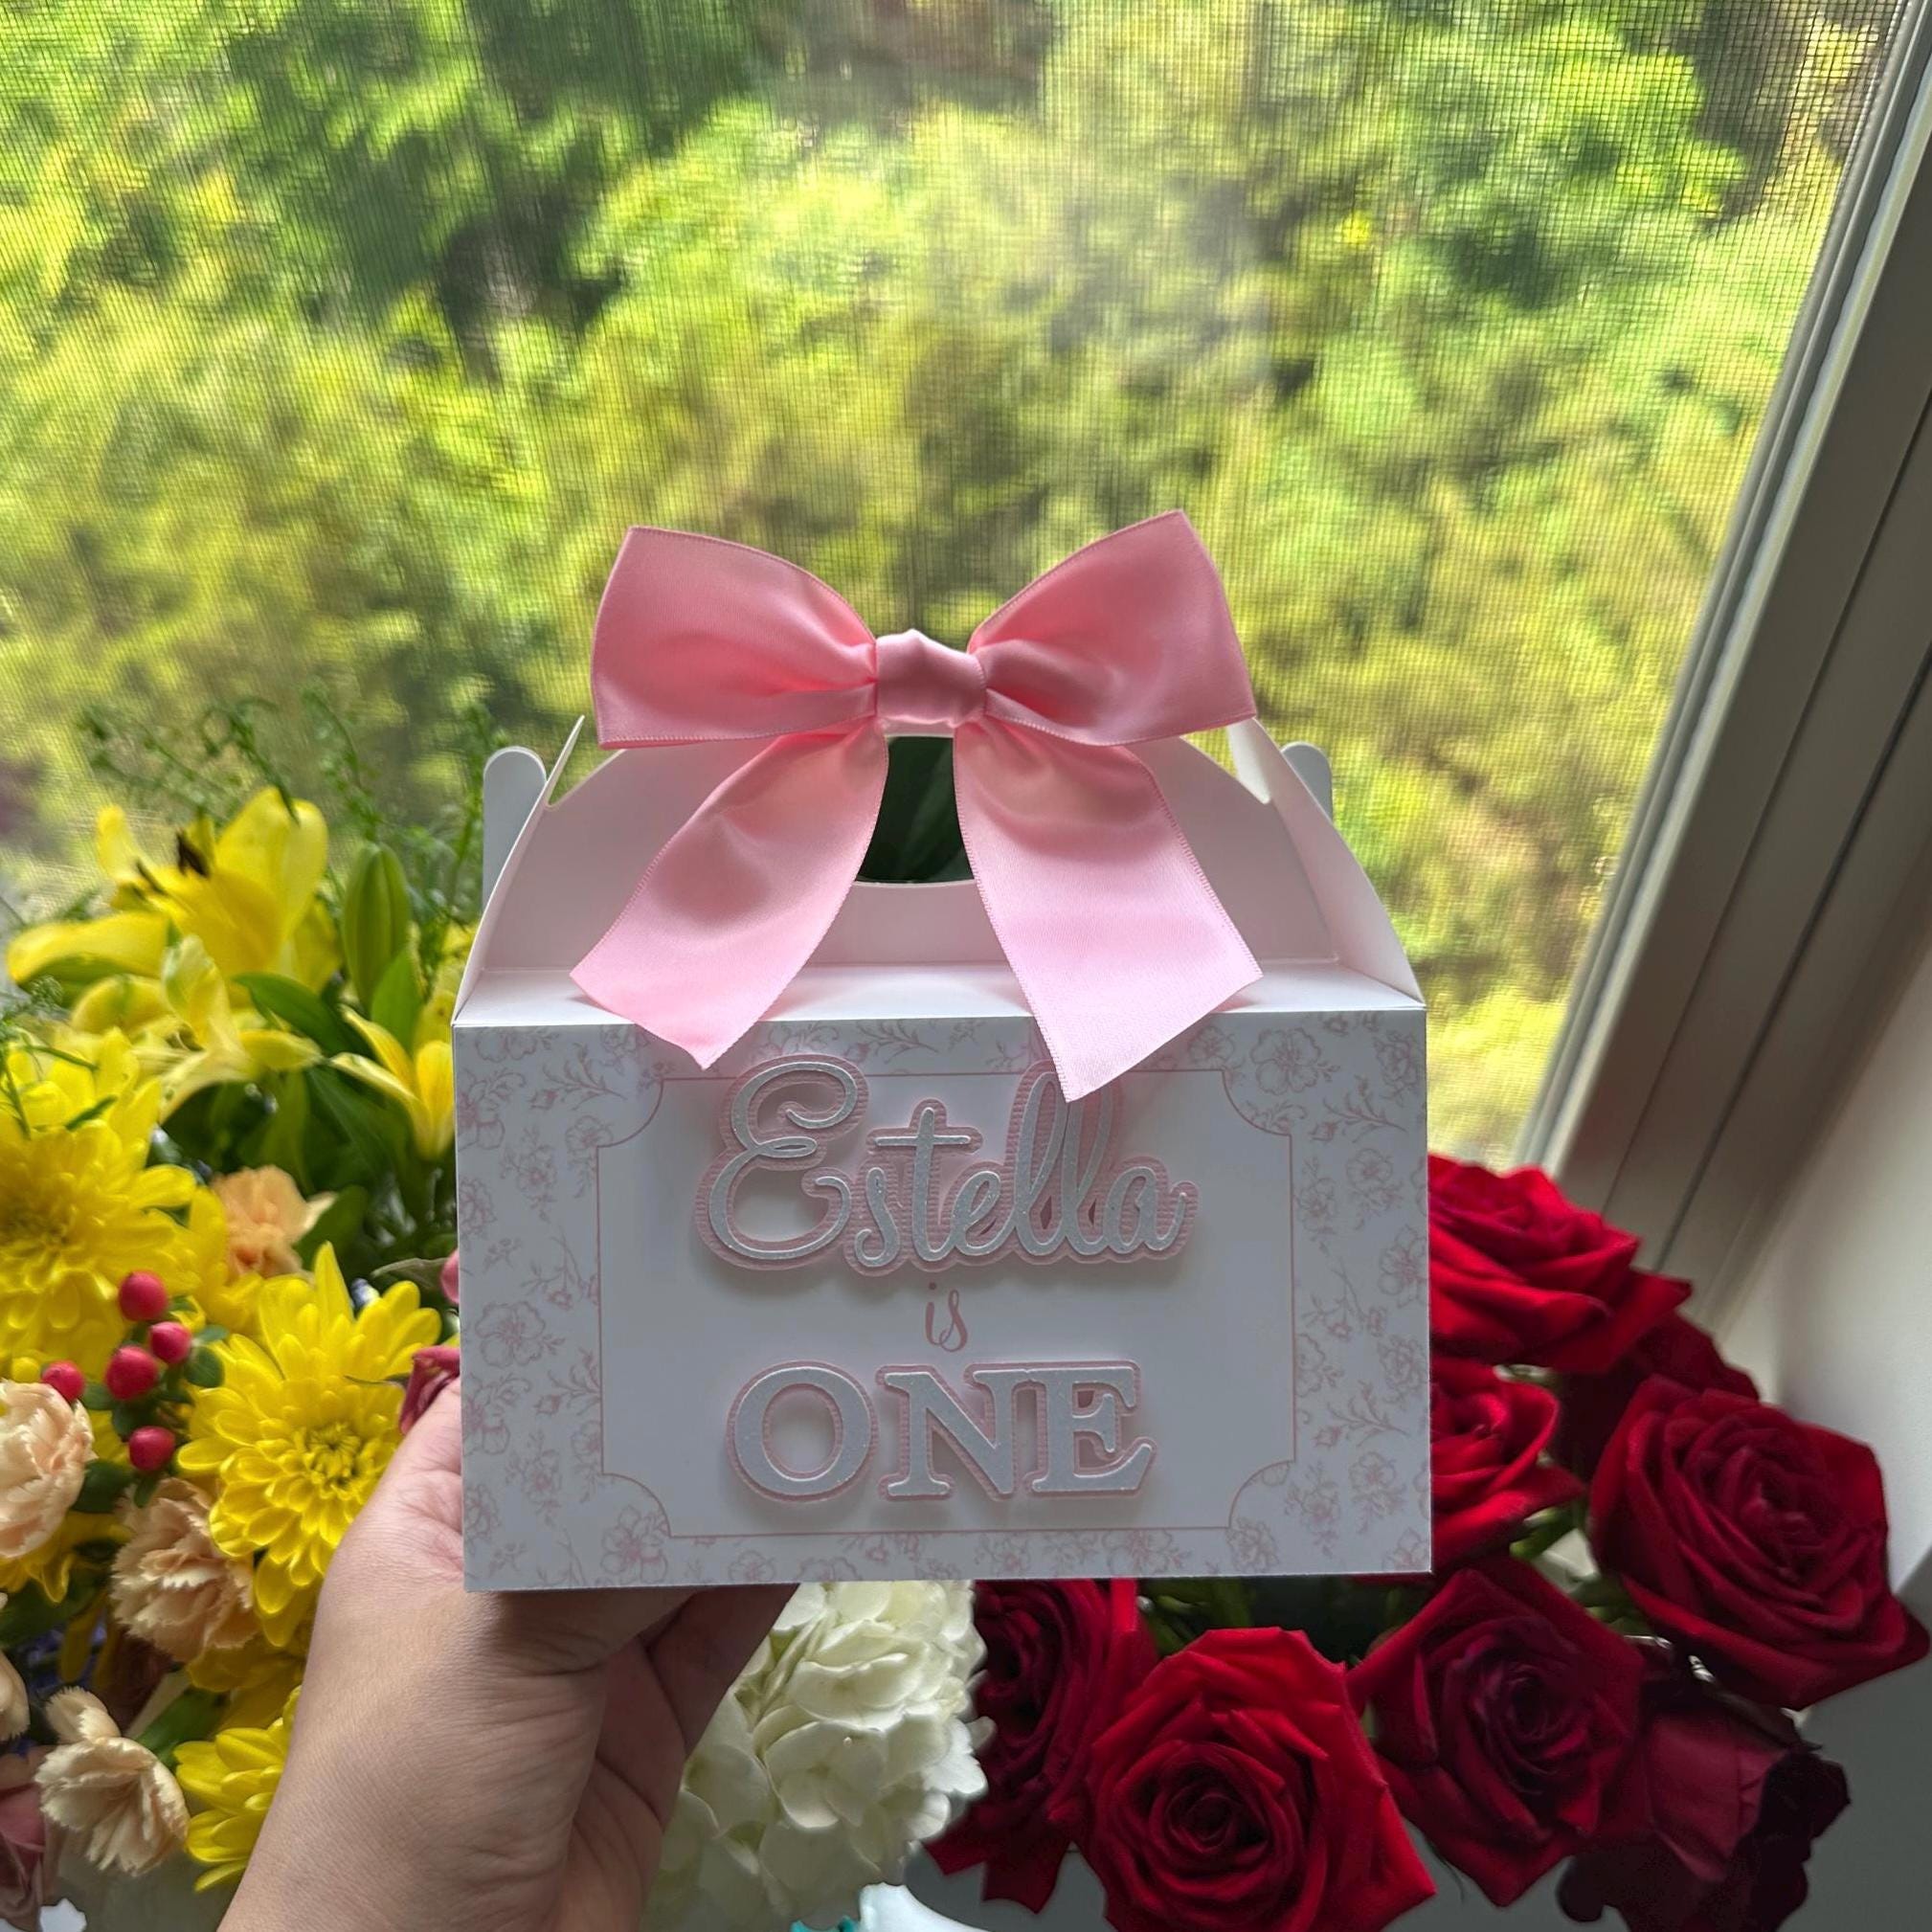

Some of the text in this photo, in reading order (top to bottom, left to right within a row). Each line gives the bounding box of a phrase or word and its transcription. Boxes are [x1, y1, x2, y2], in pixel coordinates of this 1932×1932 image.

[706, 1059, 1188, 1270] Estella
[924, 1281, 969, 1353] is
[730, 1364, 1155, 1499] ONE
